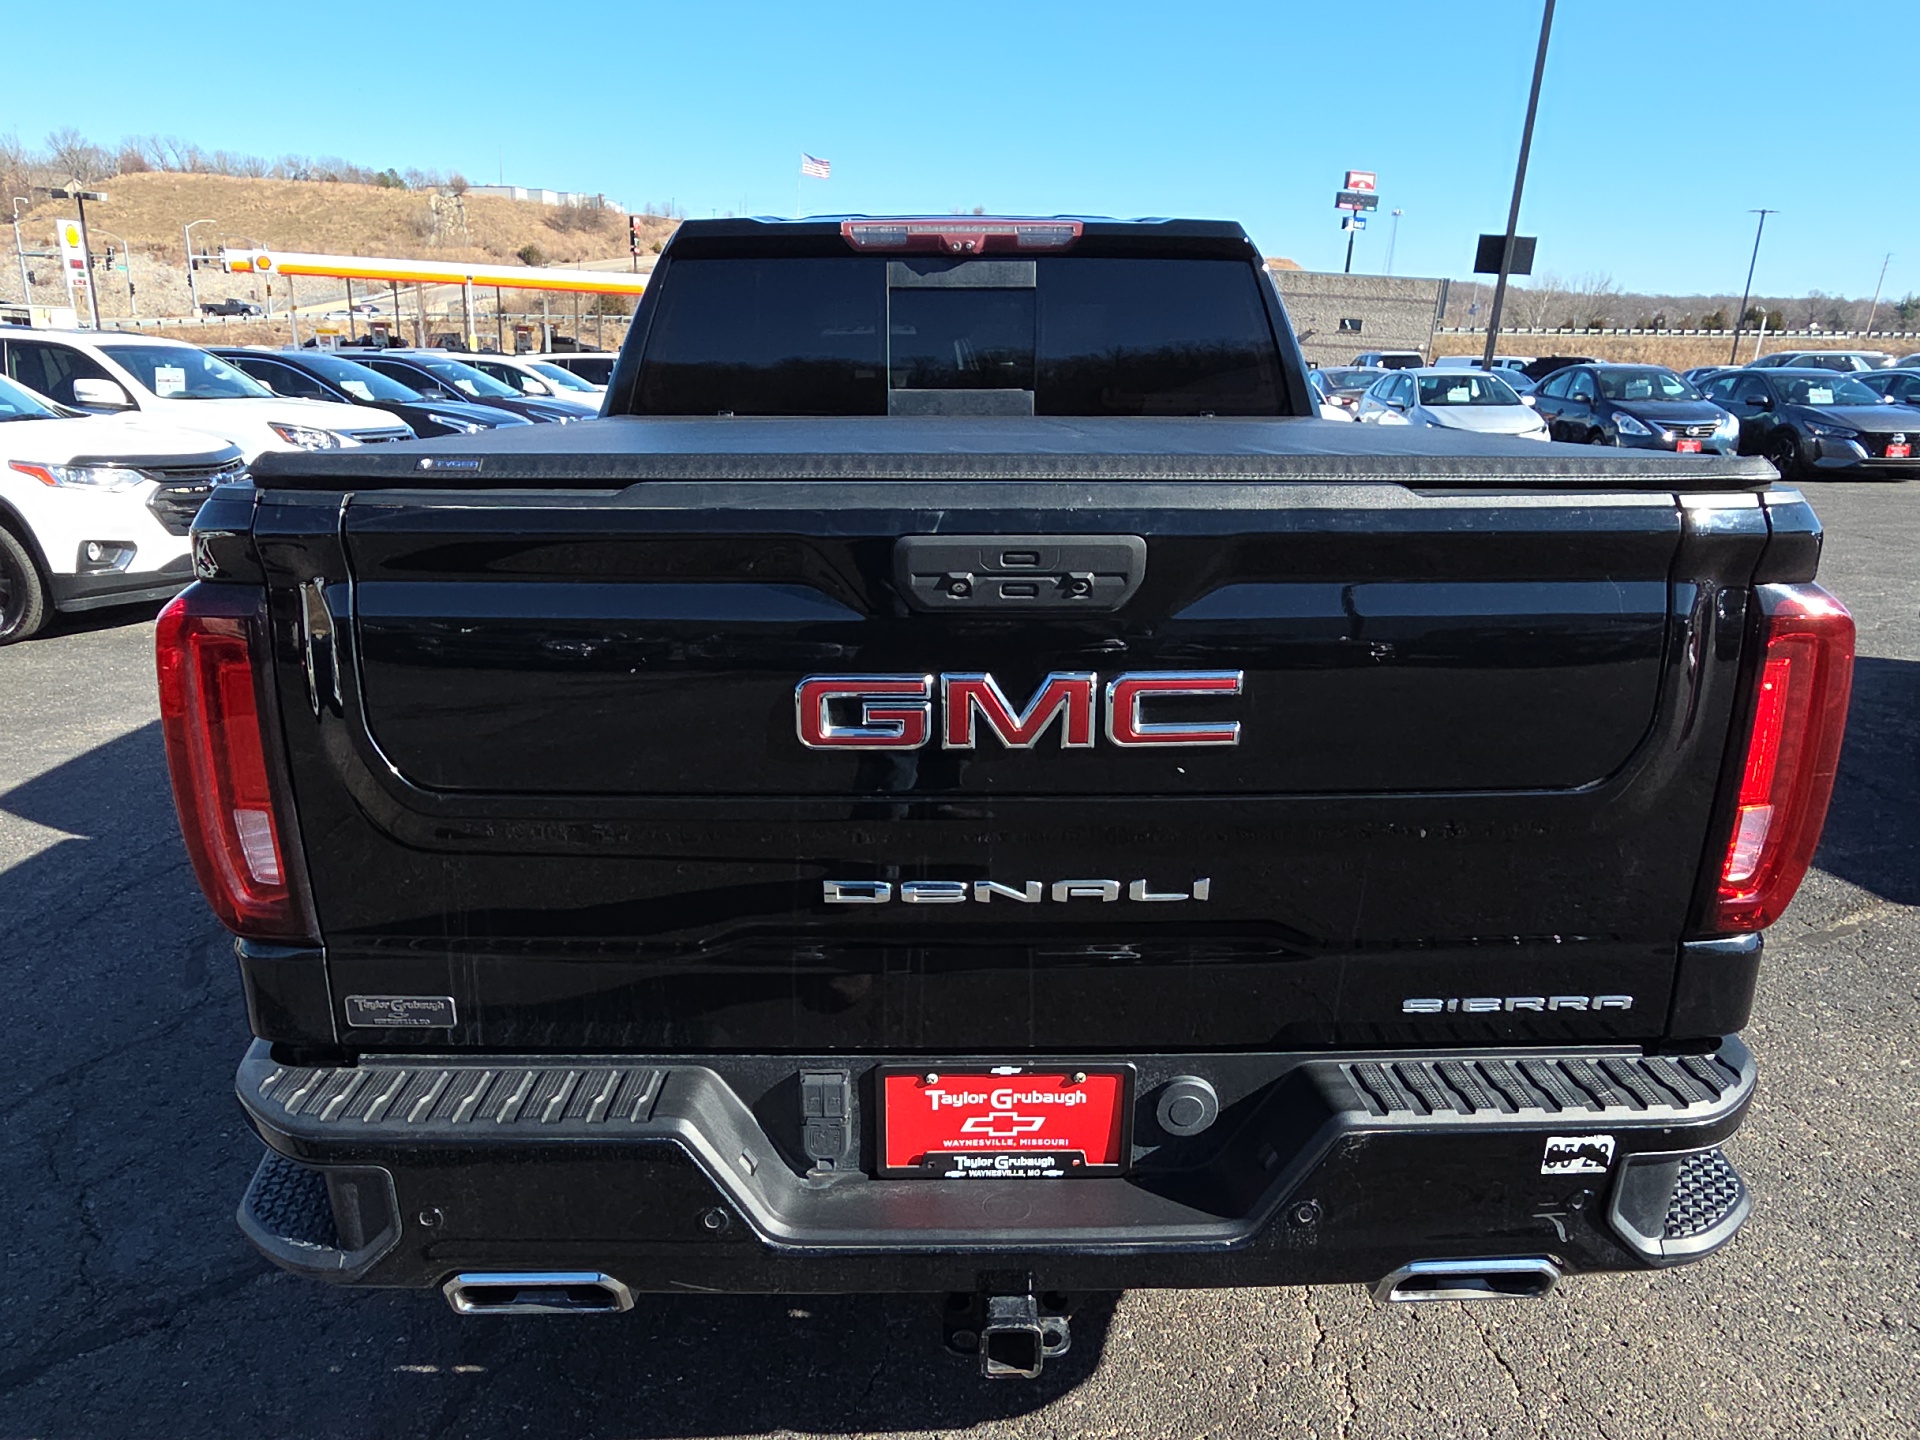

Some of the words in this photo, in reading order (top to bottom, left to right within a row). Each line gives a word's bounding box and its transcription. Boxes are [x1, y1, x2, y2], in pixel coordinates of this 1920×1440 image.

[795, 669, 1244, 751] GMC
[823, 877, 1211, 905] DENALI
[354, 999, 390, 1012] Taylor
[390, 999, 445, 1013] Grubaugh
[1402, 995, 1634, 1014] SIERRA
[925, 1090, 988, 1110] Taylor
[991, 1089, 1087, 1109] Grubaugh
[943, 1138, 1017, 1147] WAYNESVILLE,
[1019, 1138, 1069, 1147] MISSOURI
[954, 1156, 993, 1170] Taylor
[994, 1155, 1056, 1169] Grubaugh
[1027, 1169, 1041, 1177] MO
